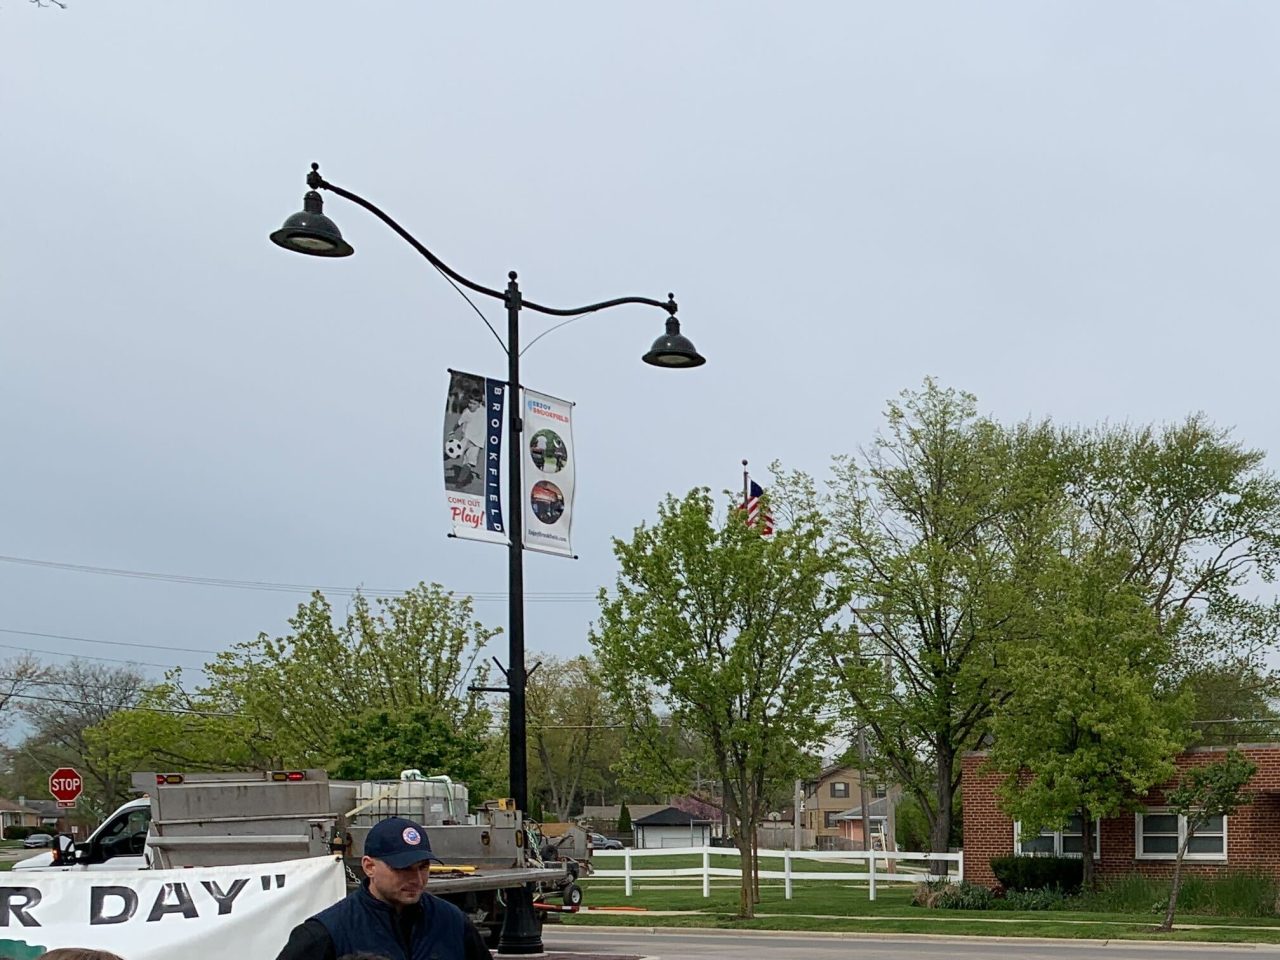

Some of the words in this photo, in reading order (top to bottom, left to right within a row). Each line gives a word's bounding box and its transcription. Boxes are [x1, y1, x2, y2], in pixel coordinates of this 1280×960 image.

[489, 386, 503, 531] BROOKFIELD
[448, 496, 466, 505] COME
[450, 506, 485, 529] Play!
[52, 778, 80, 791] STOP
